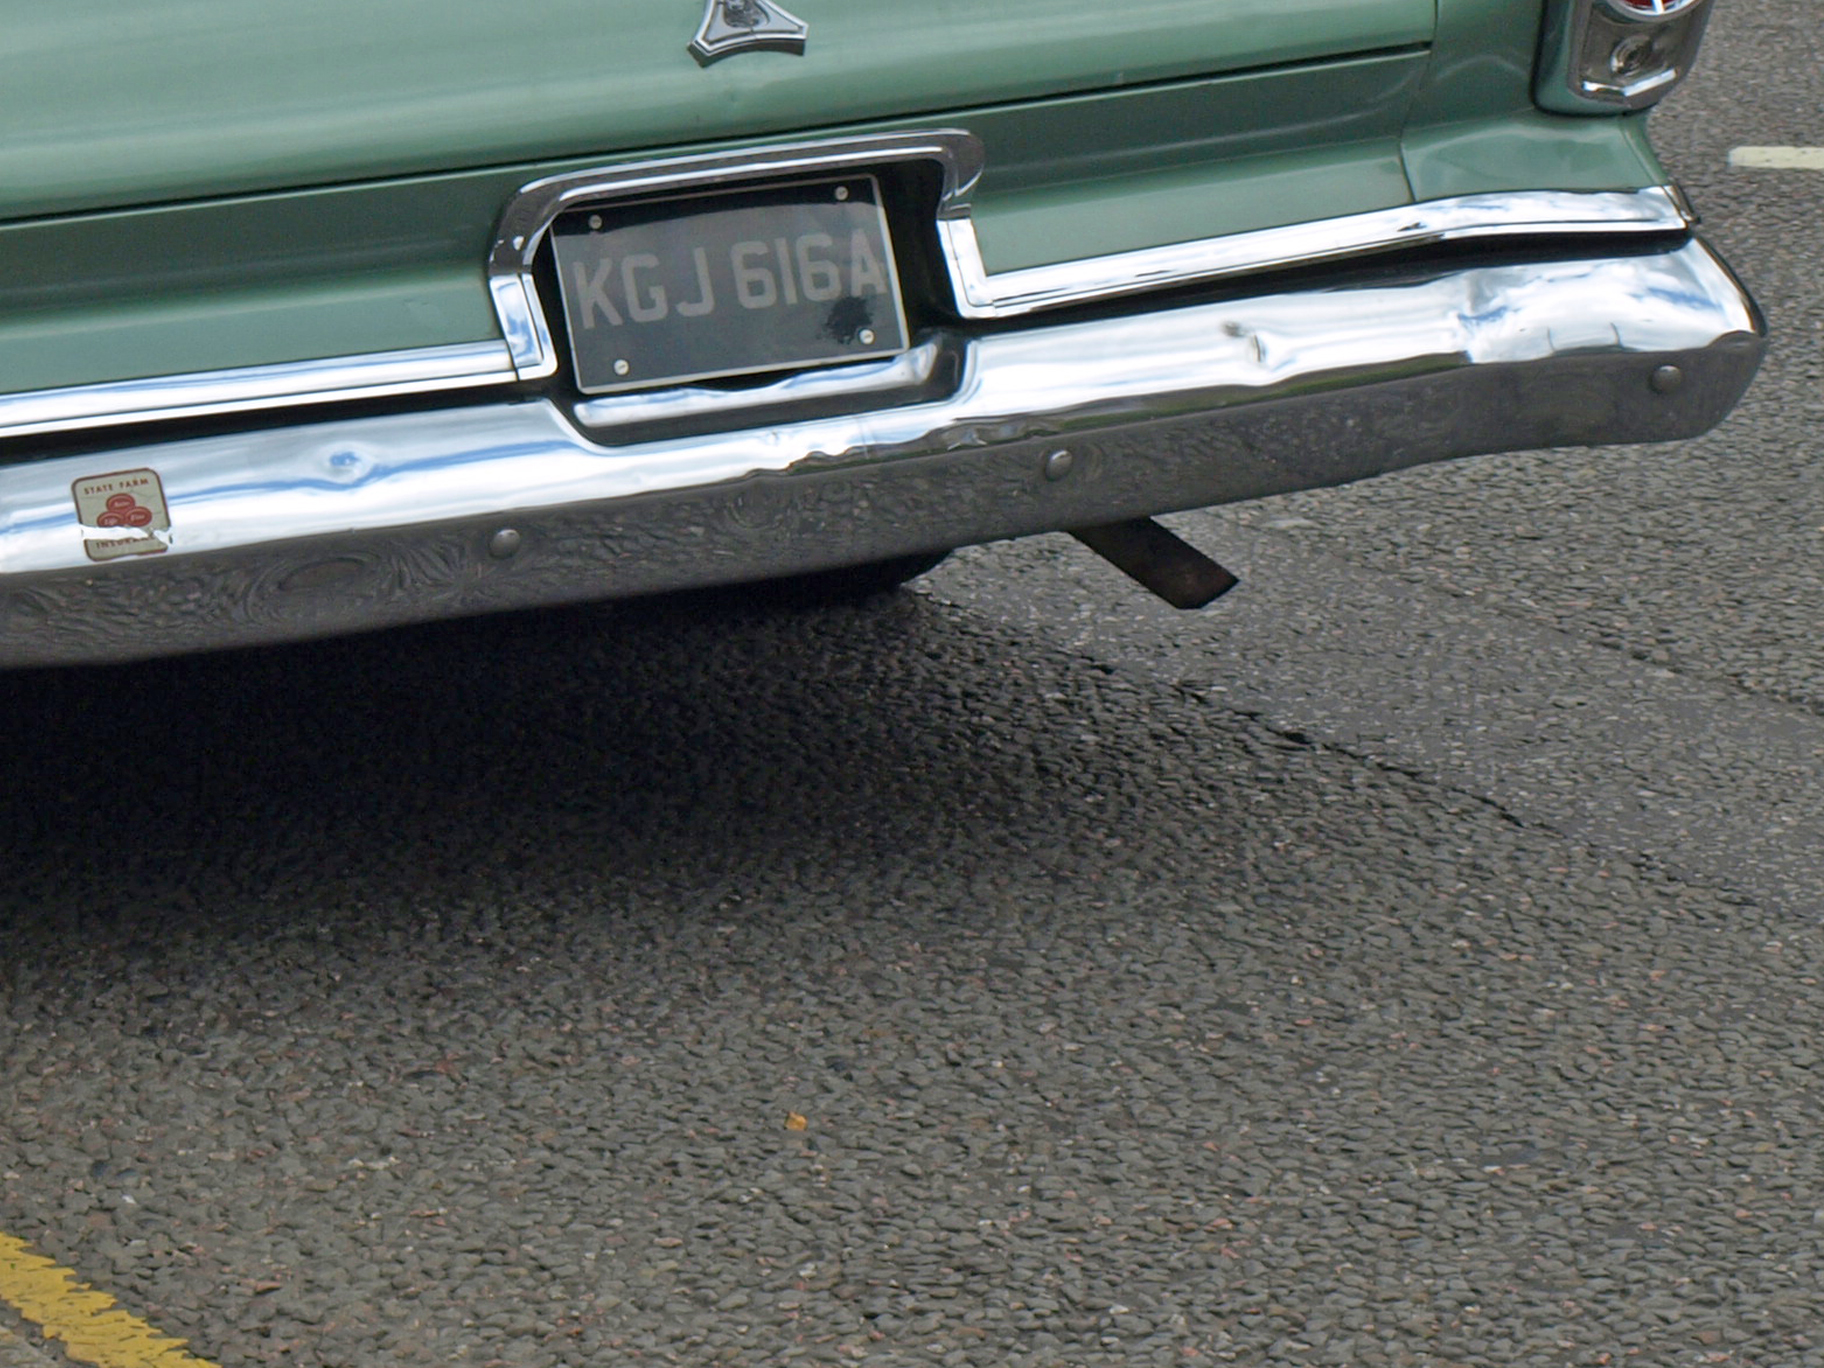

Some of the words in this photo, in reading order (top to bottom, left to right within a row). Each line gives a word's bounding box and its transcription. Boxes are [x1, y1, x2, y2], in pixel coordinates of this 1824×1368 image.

[572, 246, 715, 330] KGJ
[730, 227, 889, 310] 616A
[84, 483, 114, 495] STATE
[118, 478, 150, 489] FARM
